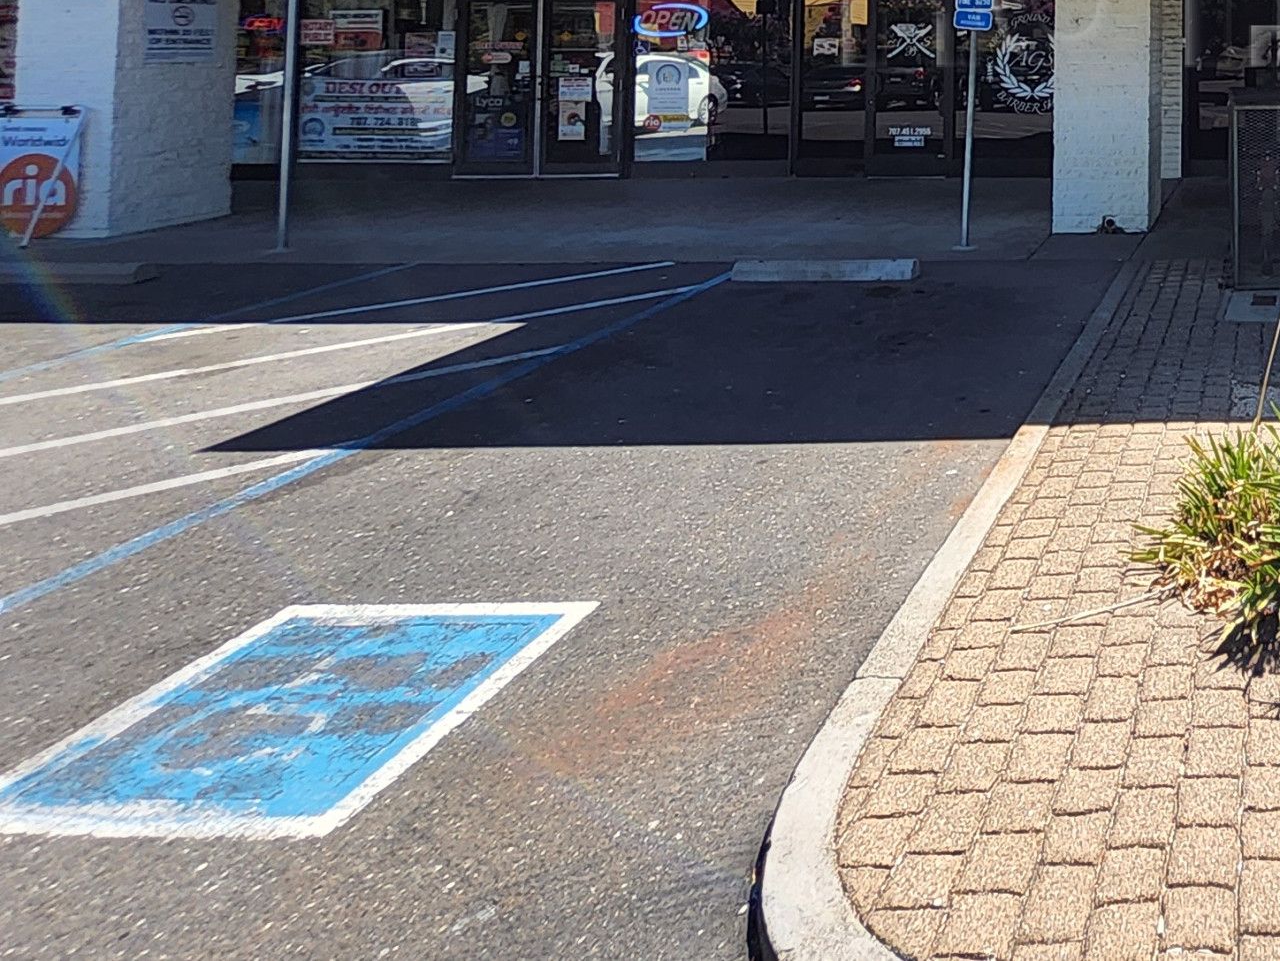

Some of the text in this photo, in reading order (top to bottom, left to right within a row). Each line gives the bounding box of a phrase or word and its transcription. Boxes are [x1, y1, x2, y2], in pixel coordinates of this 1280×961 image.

[642, 10, 699, 31] OPEN
[324, 82, 364, 94] DESI
[476, 97, 503, 107] Lyca
[4, 164, 66, 206] ria
